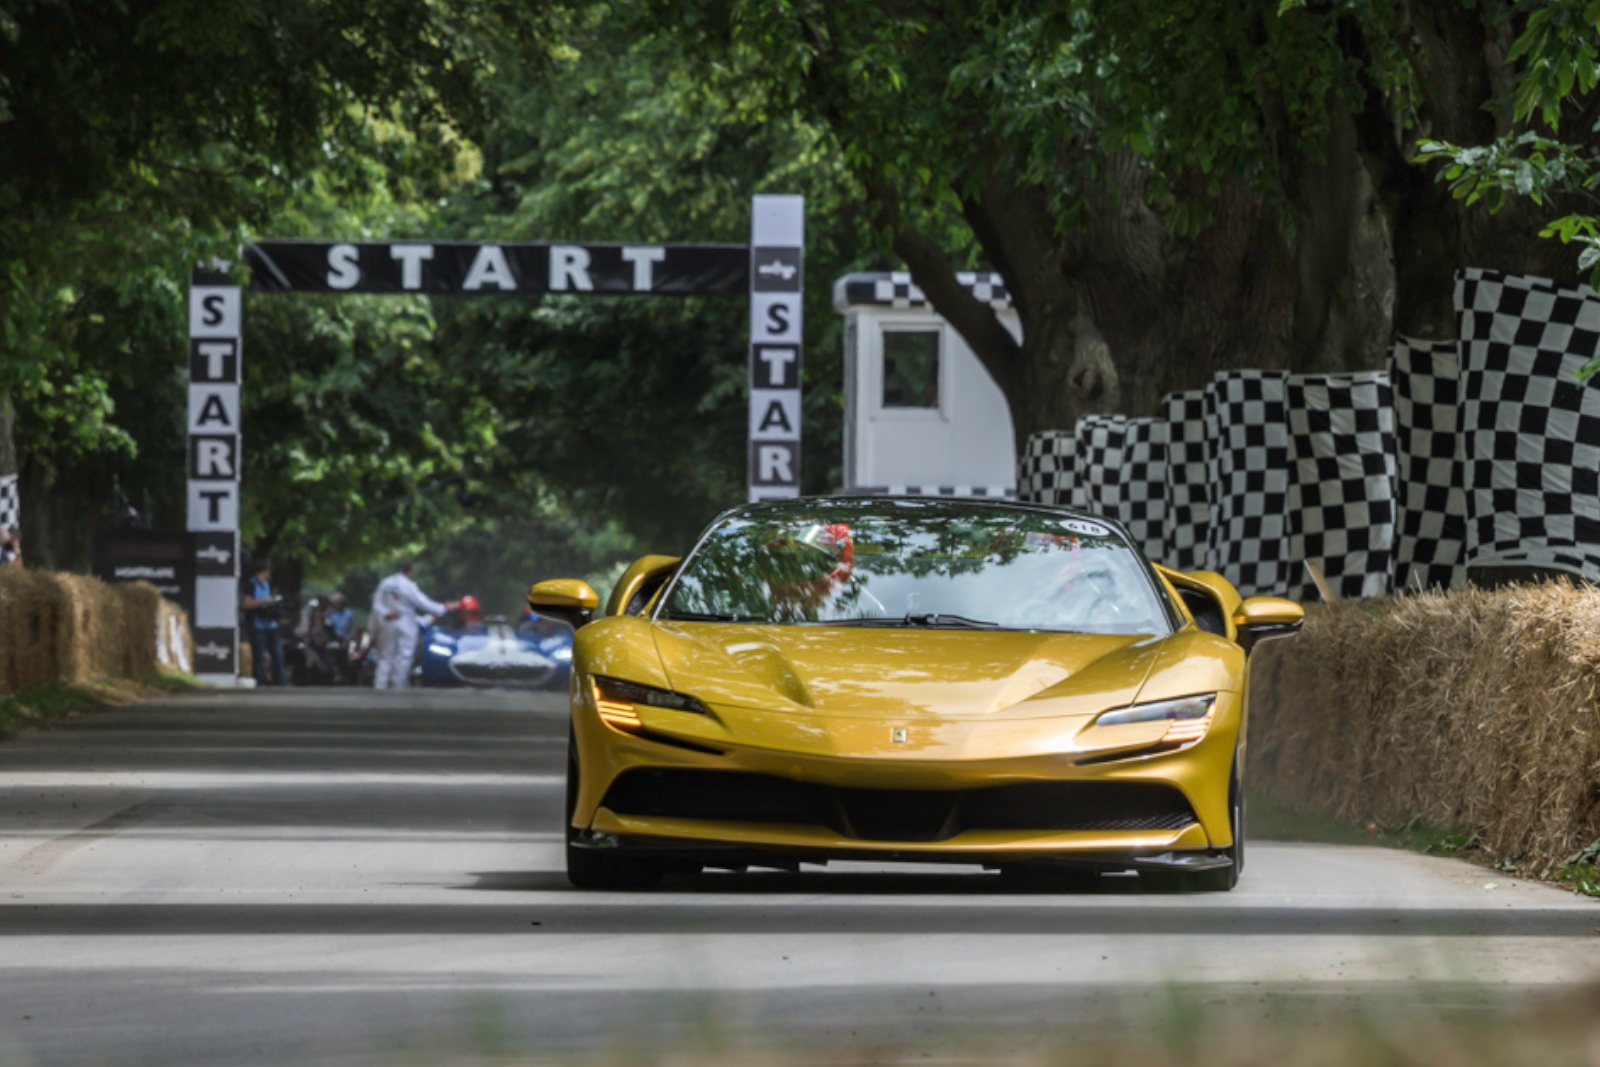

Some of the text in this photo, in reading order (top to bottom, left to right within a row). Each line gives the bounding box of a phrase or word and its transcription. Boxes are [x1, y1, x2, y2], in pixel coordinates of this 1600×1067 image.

[326, 243, 666, 291] START
[196, 295, 234, 523] START
[757, 304, 796, 501] STAR
